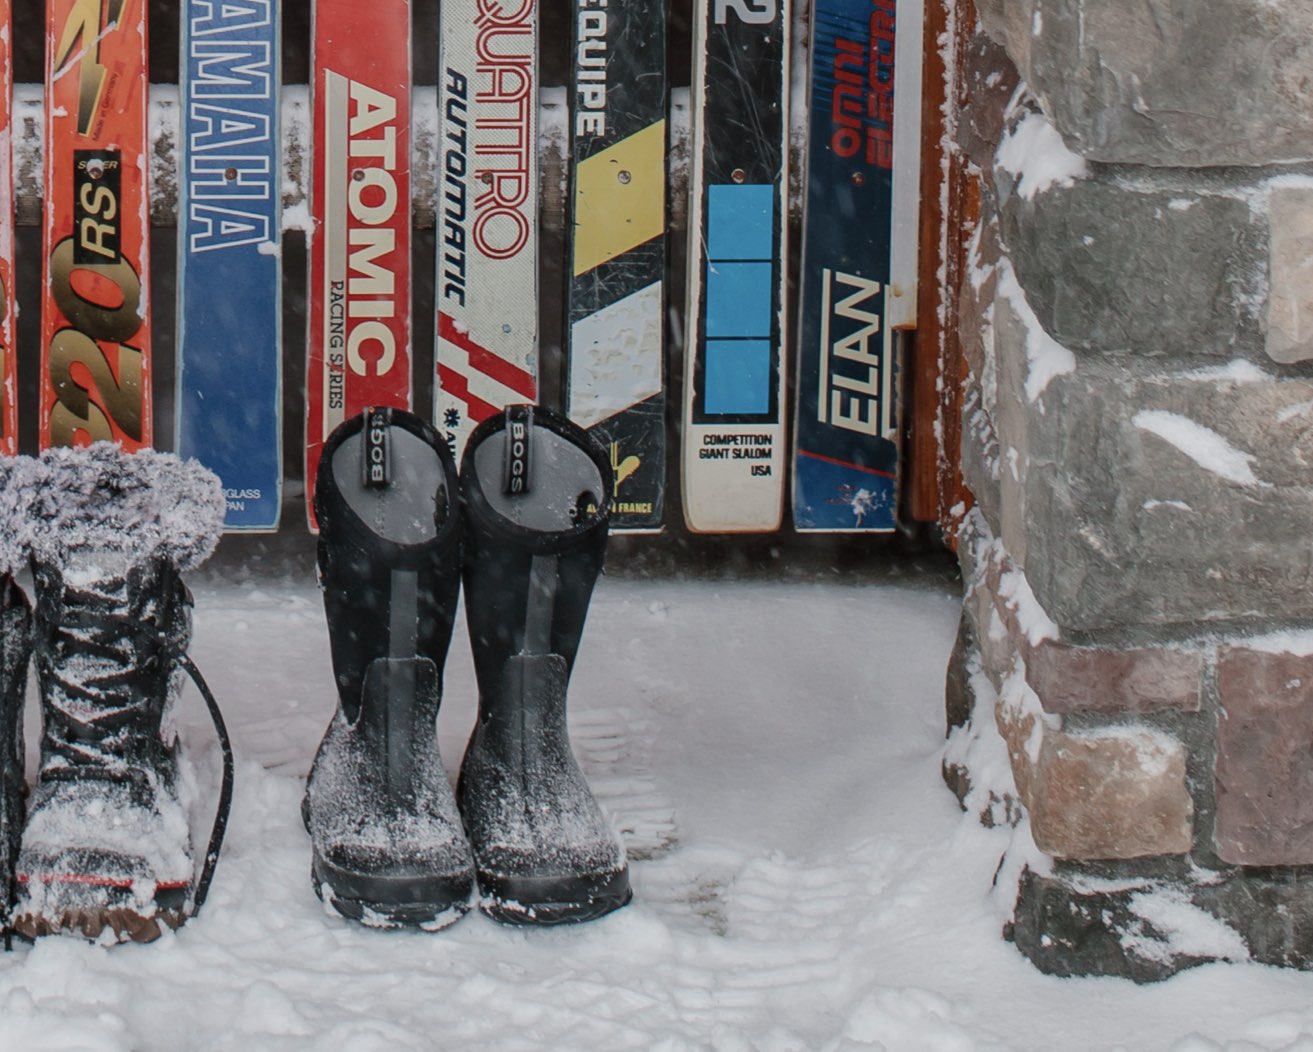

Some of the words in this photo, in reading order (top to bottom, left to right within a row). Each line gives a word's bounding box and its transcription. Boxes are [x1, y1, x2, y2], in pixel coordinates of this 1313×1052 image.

[576, 0, 607, 136] QUIPE
[92, 119, 104, 142] Made
[101, 71, 120, 108] Germany
[77, 160, 118, 170] SER
[445, 67, 468, 308] AUTOMATIC
[80, 182, 117, 259] RS
[347, 82, 397, 377] ATOMIC
[329, 280, 344, 348] RACING
[830, 272, 882, 437] ELAN
[511, 423, 524, 492] BOGS
[699, 447, 729, 459] GIANT
[732, 447, 772, 459] SLALOM
[703, 434, 772, 446] COMPETITION
[751, 465, 771, 476] USA
[618, 502, 653, 513] FRANCE
